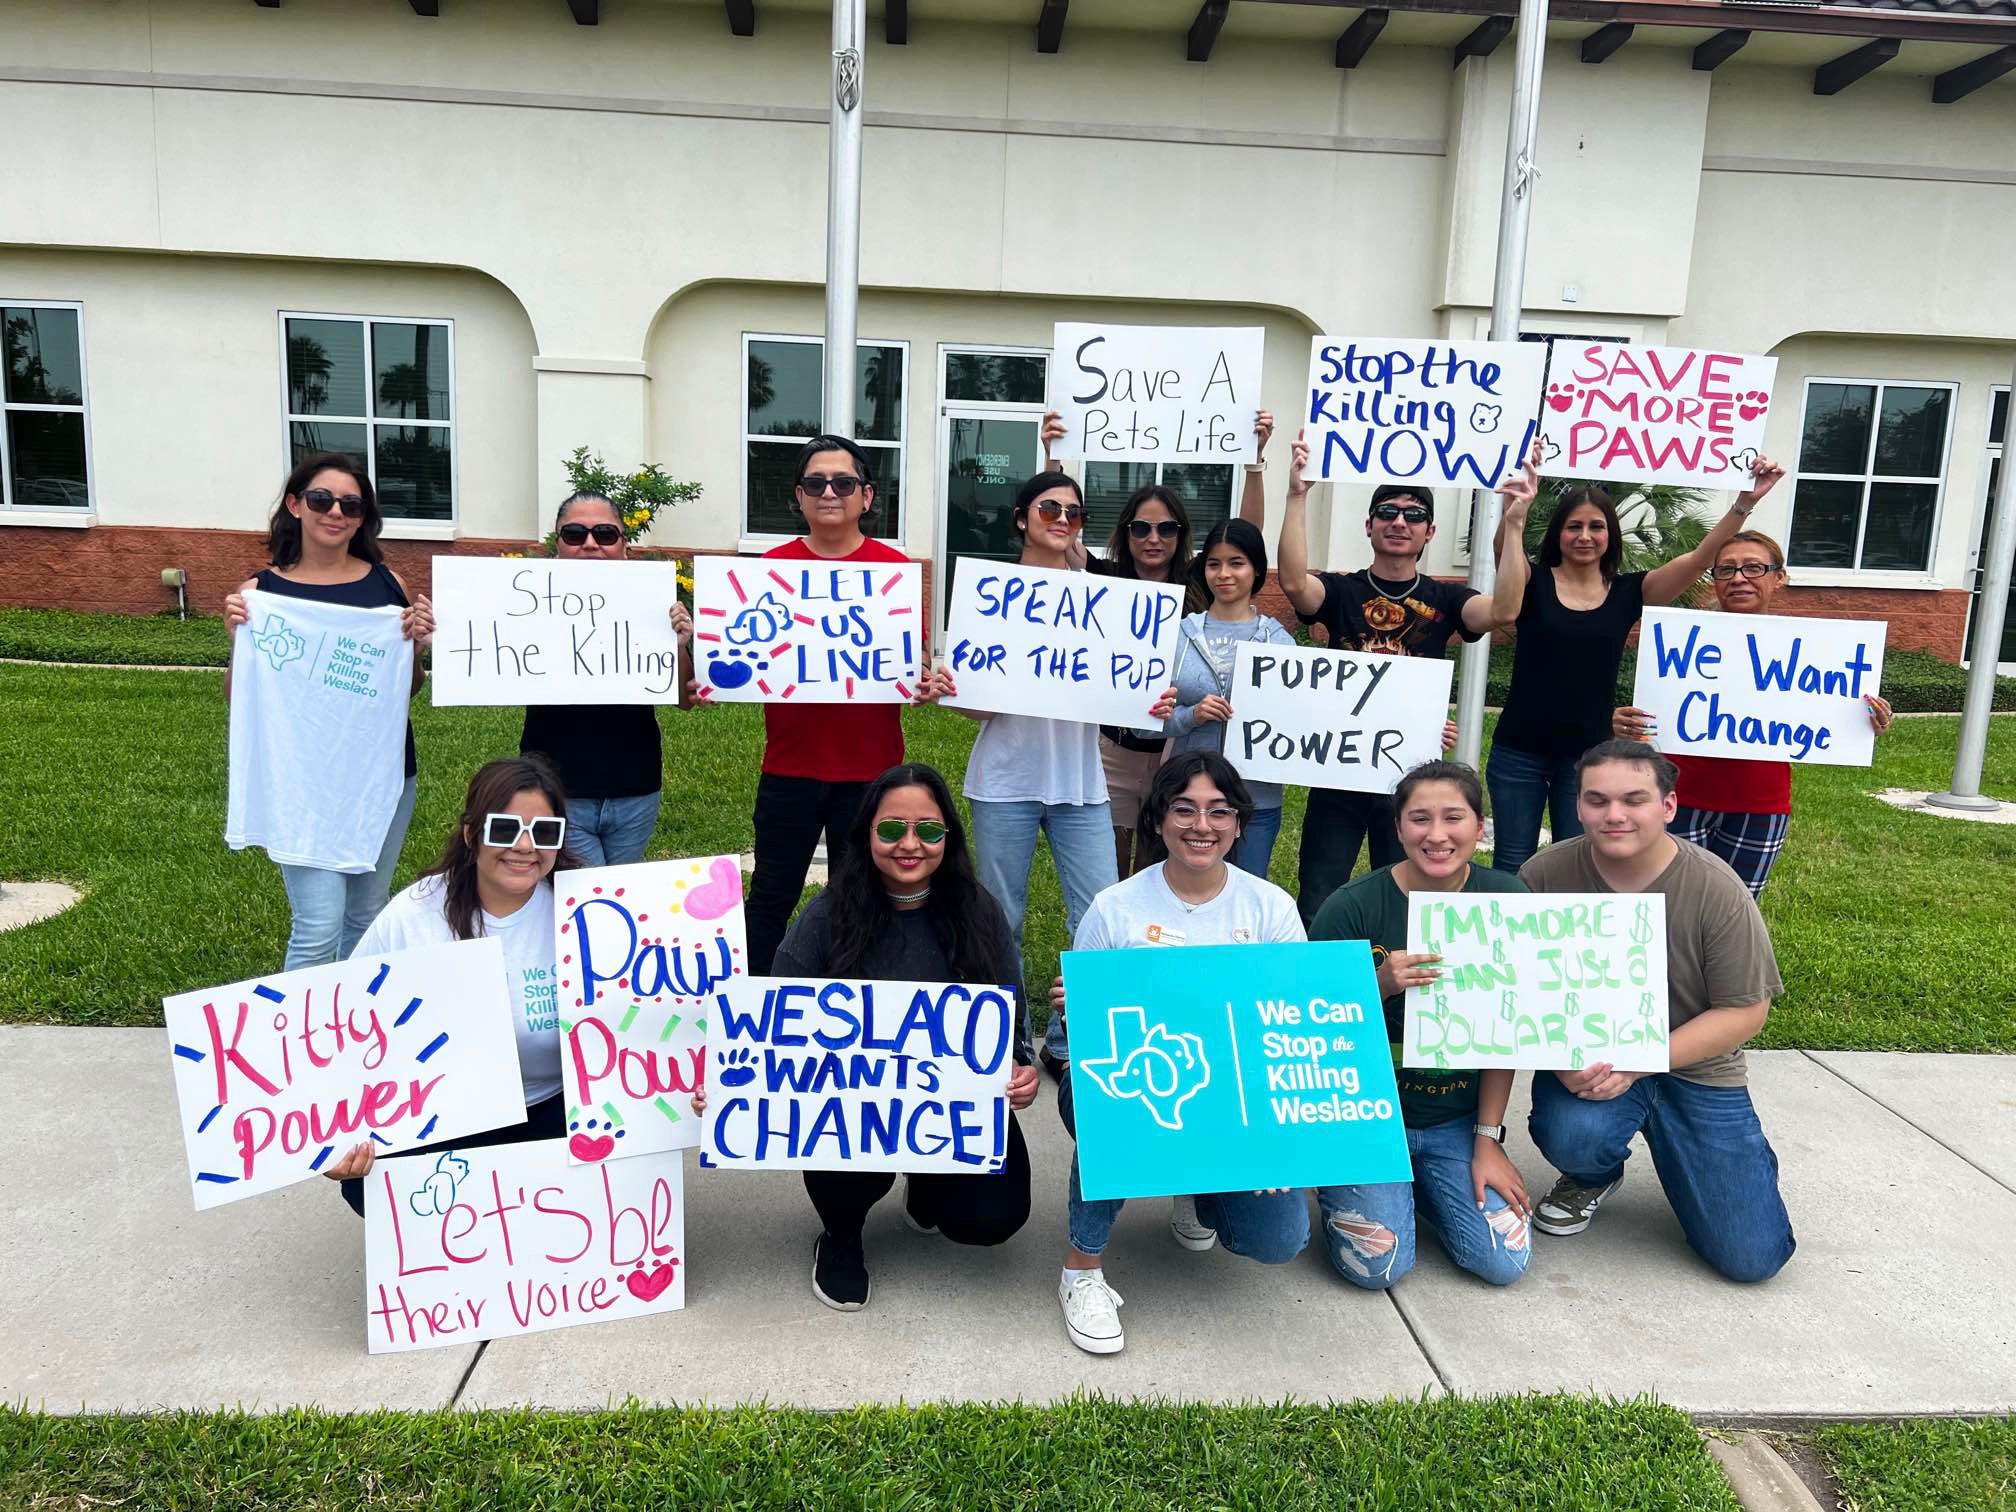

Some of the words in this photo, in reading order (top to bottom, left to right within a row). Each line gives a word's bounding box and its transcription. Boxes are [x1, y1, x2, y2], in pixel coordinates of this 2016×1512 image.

[1073, 336, 1181, 404] Save
[1201, 350, 1236, 403] A
[1320, 344, 1414, 394] Stop
[1417, 346, 1502, 395] the
[1573, 346, 1744, 401] SAVE
[1083, 409, 1160, 452] Pets
[1176, 409, 1242, 452] Life
[1310, 389, 1456, 453] Killing
[1582, 389, 1734, 434] MORE
[1322, 419, 1536, 489] NOW!
[1569, 420, 1734, 474] PAWS
[507, 570, 605, 628] Stop
[801, 569, 877, 601] LET
[821, 606, 873, 647] US
[976, 576, 1109, 639] SPEAK
[1130, 591, 1178, 648] UP
[328, 661, 369, 684] Killing
[332, 649, 362, 671] Stop
[338, 636, 357, 650] We
[361, 643, 386, 657] Can
[449, 620, 546, 677] the
[571, 620, 675, 693] Killing
[798, 631, 914, 683] LIVE!
[952, 638, 1007, 676] FOR
[1027, 645, 1091, 682] THE
[1111, 652, 1166, 692] PUP
[1653, 622, 1722, 680] We
[1746, 633, 1872, 699] Want
[323, 674, 377, 698] Weslaco
[1251, 655, 1392, 717] PUPPY
[1243, 719, 1405, 775] POWER
[1676, 691, 1832, 761] Change
[1420, 902, 1489, 946] I'M
[1505, 900, 1617, 942] MORE
[522, 968, 547, 983] We
[717, 982, 1011, 1076] WESLACO
[1256, 1000, 1301, 1026] We
[1308, 998, 1364, 1025] Can
[1415, 1010, 1569, 1057] DOLLAR
[1583, 1012, 1667, 1049] SIGN
[203, 982, 388, 1105] Kitty
[1263, 1031, 1327, 1065] Stop
[1332, 1036, 1356, 1052] the
[765, 1048, 943, 1094] WANTS
[1267, 1064, 1361, 1095] Killing
[1397, 1079, 1468, 1096] INGTON
[714, 1097, 1006, 1167] CHANGE!
[1271, 1092, 1394, 1126] Weslaco
[383, 1170, 593, 1277] Let's
[601, 1163, 674, 1267] be
[371, 1282, 487, 1344] their
